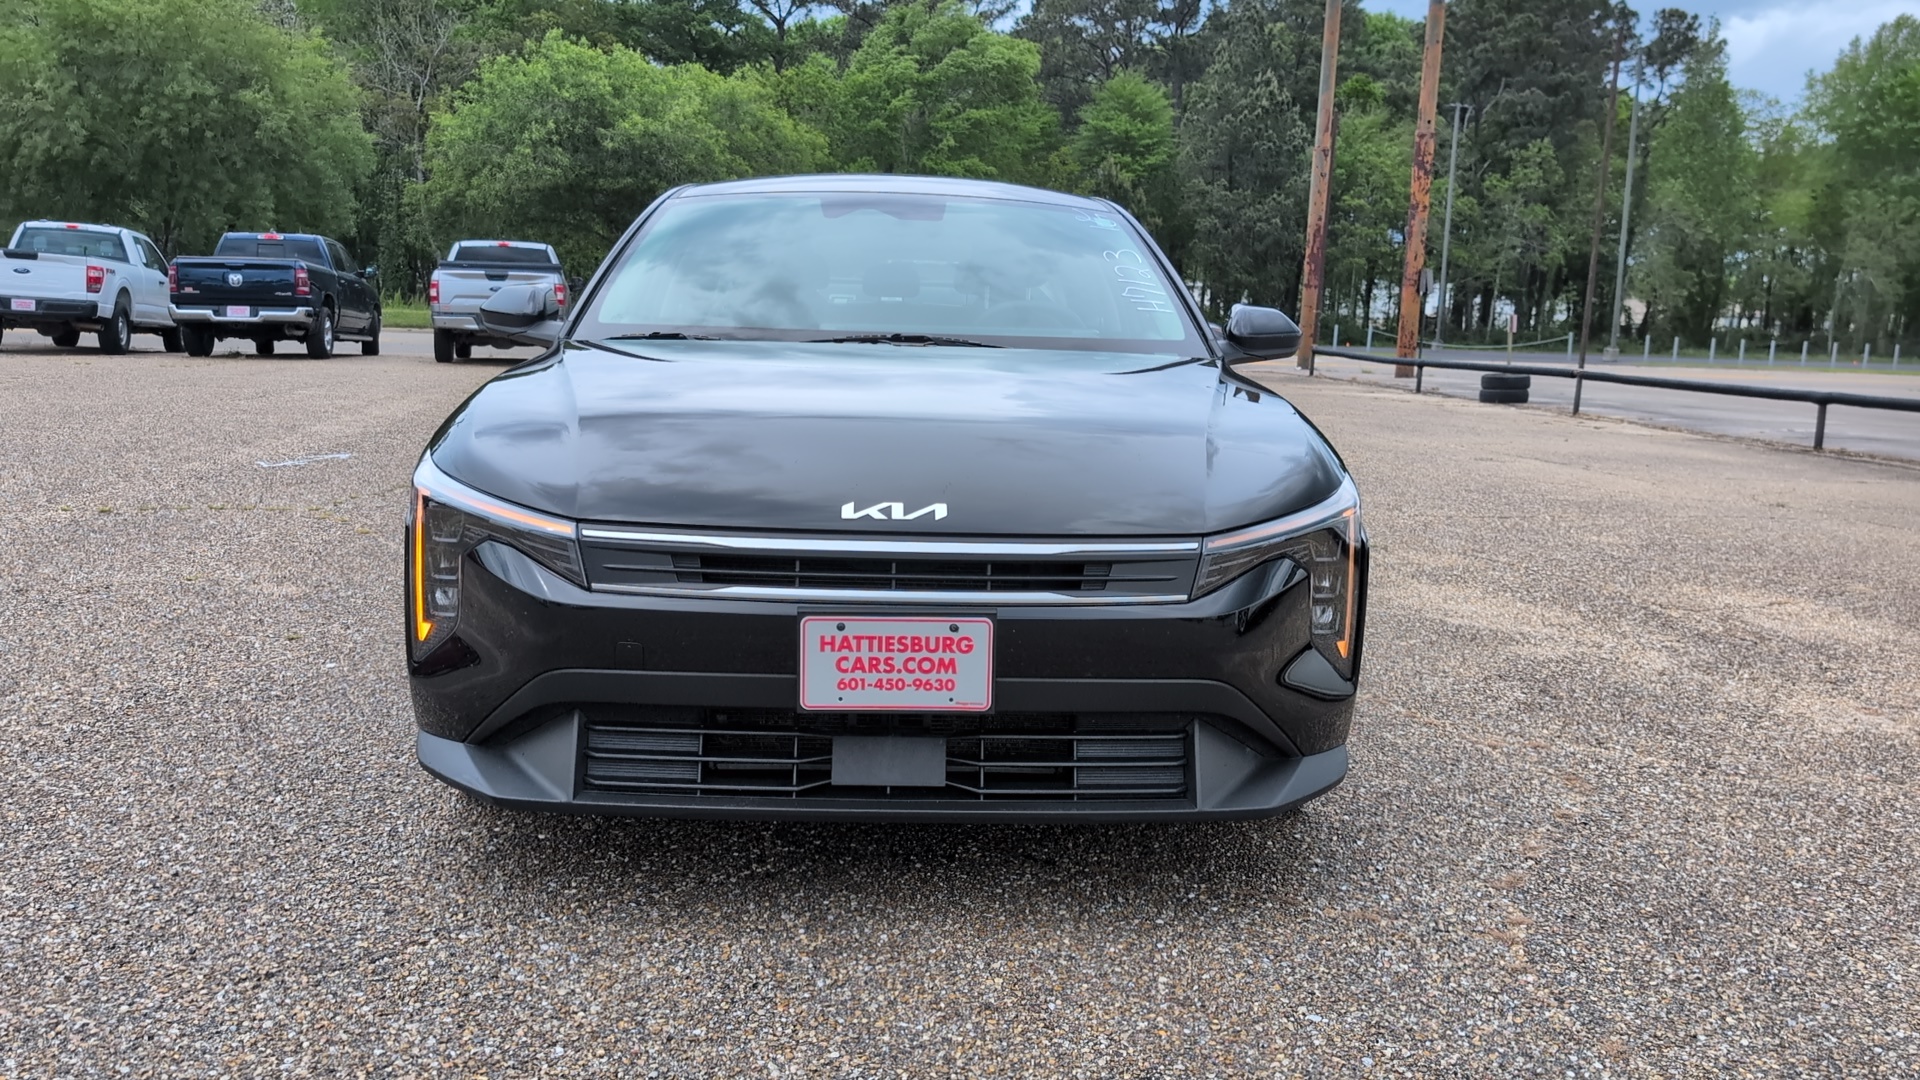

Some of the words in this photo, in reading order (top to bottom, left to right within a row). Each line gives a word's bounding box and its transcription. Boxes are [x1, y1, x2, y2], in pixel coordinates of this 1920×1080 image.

[841, 501, 948, 521] KIA
[819, 635, 974, 654] HATTIESBURG
[835, 656, 957, 675] CARS.COM
[836, 677, 956, 692] 601-450-9630
